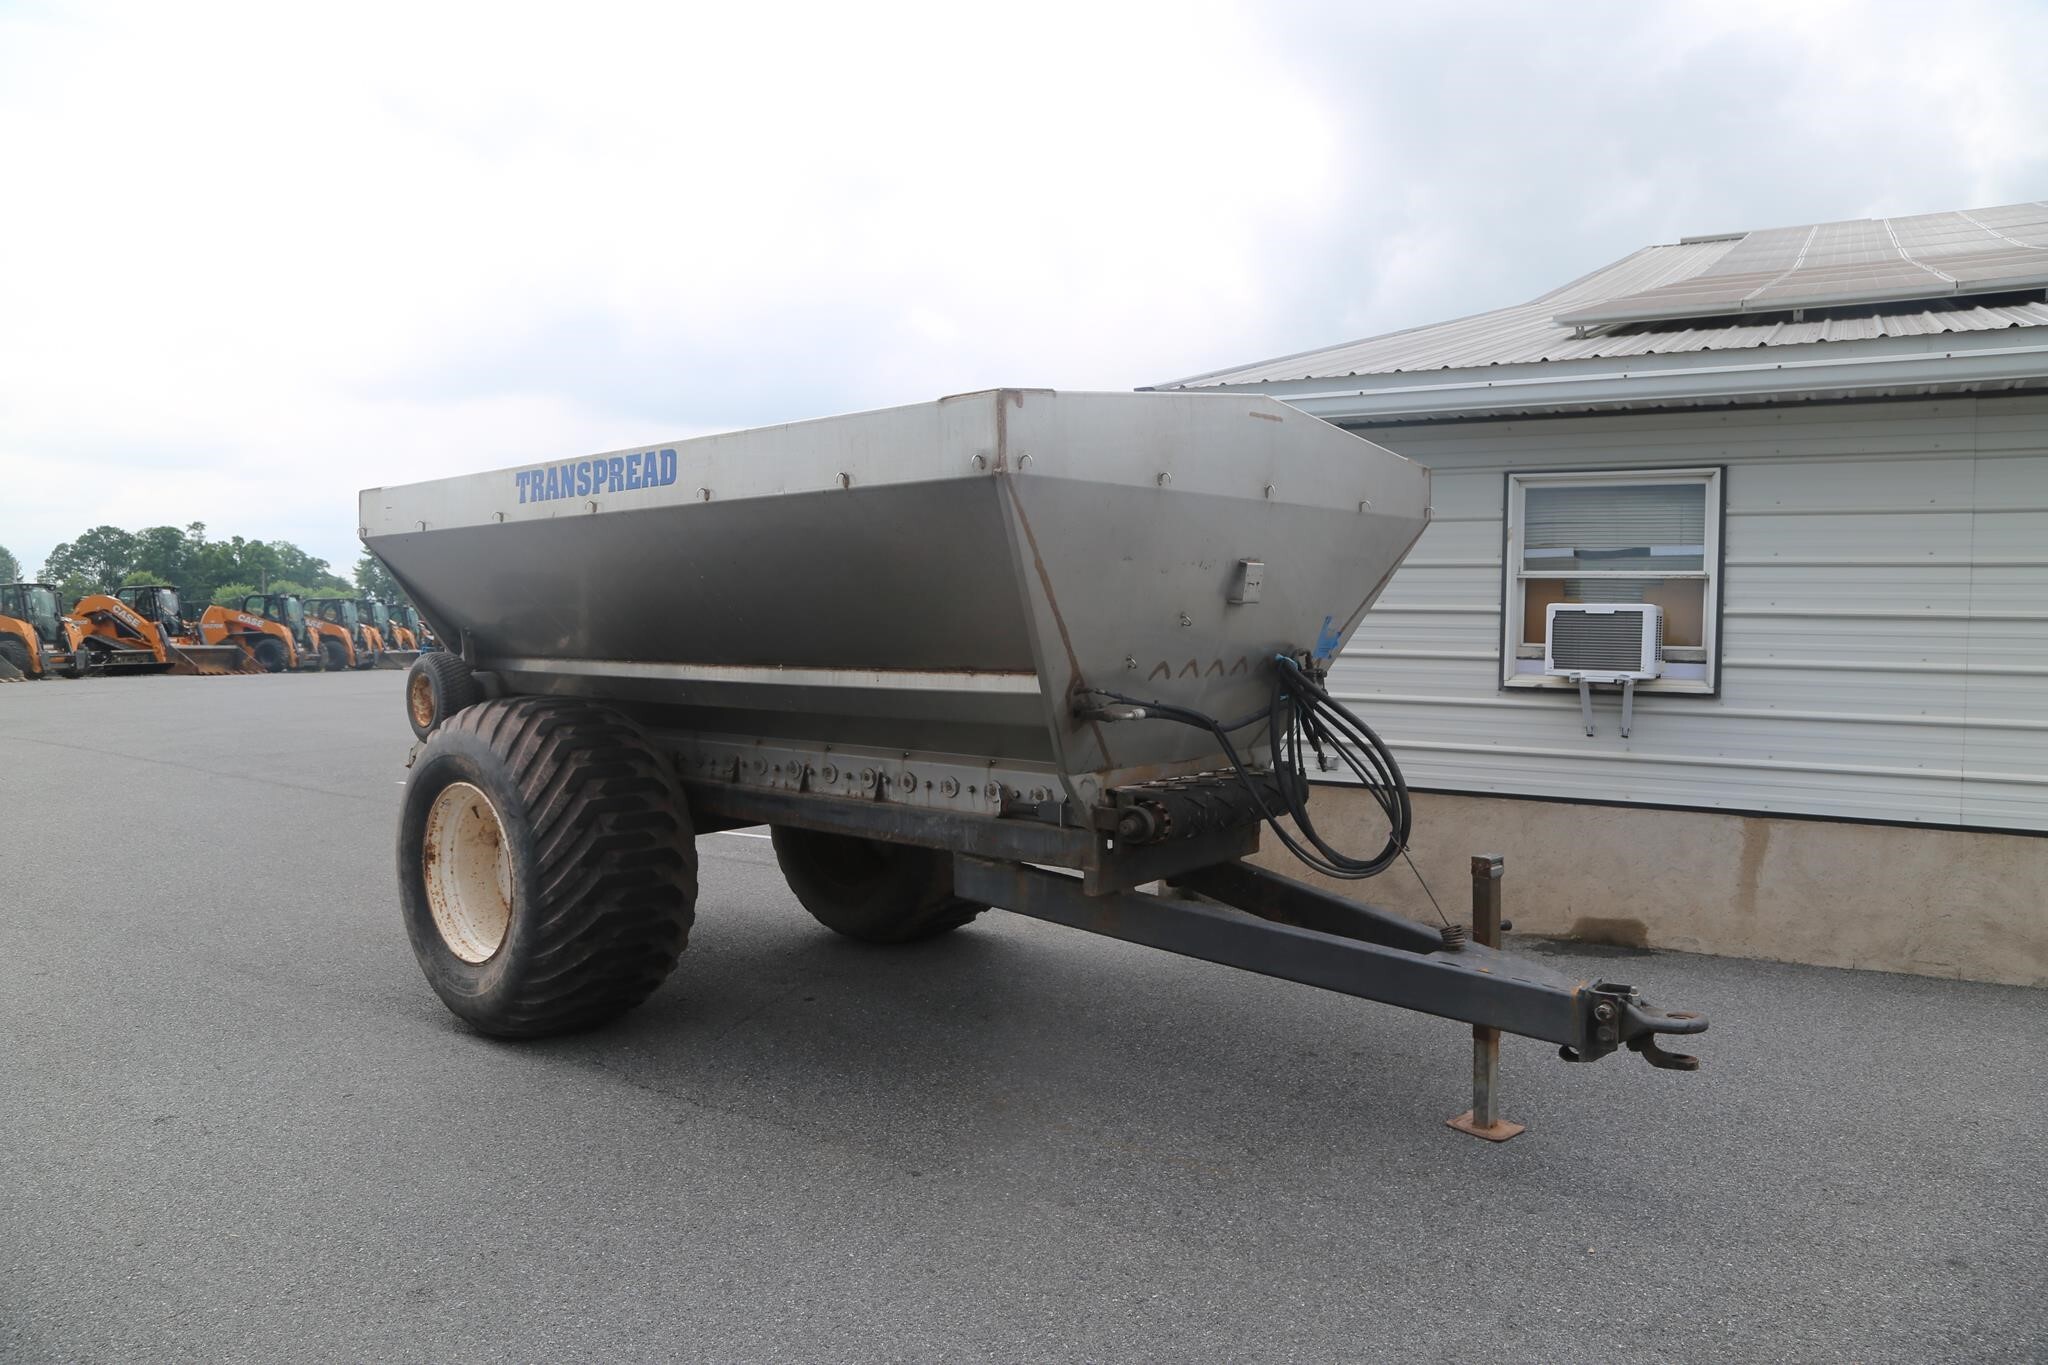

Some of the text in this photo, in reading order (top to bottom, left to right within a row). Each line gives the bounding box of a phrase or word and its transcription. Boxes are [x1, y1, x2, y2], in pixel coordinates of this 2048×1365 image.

[515, 448, 678, 504] TRANSPREAD
[112, 604, 141, 627] CASE
[238, 614, 265, 627] CASE
